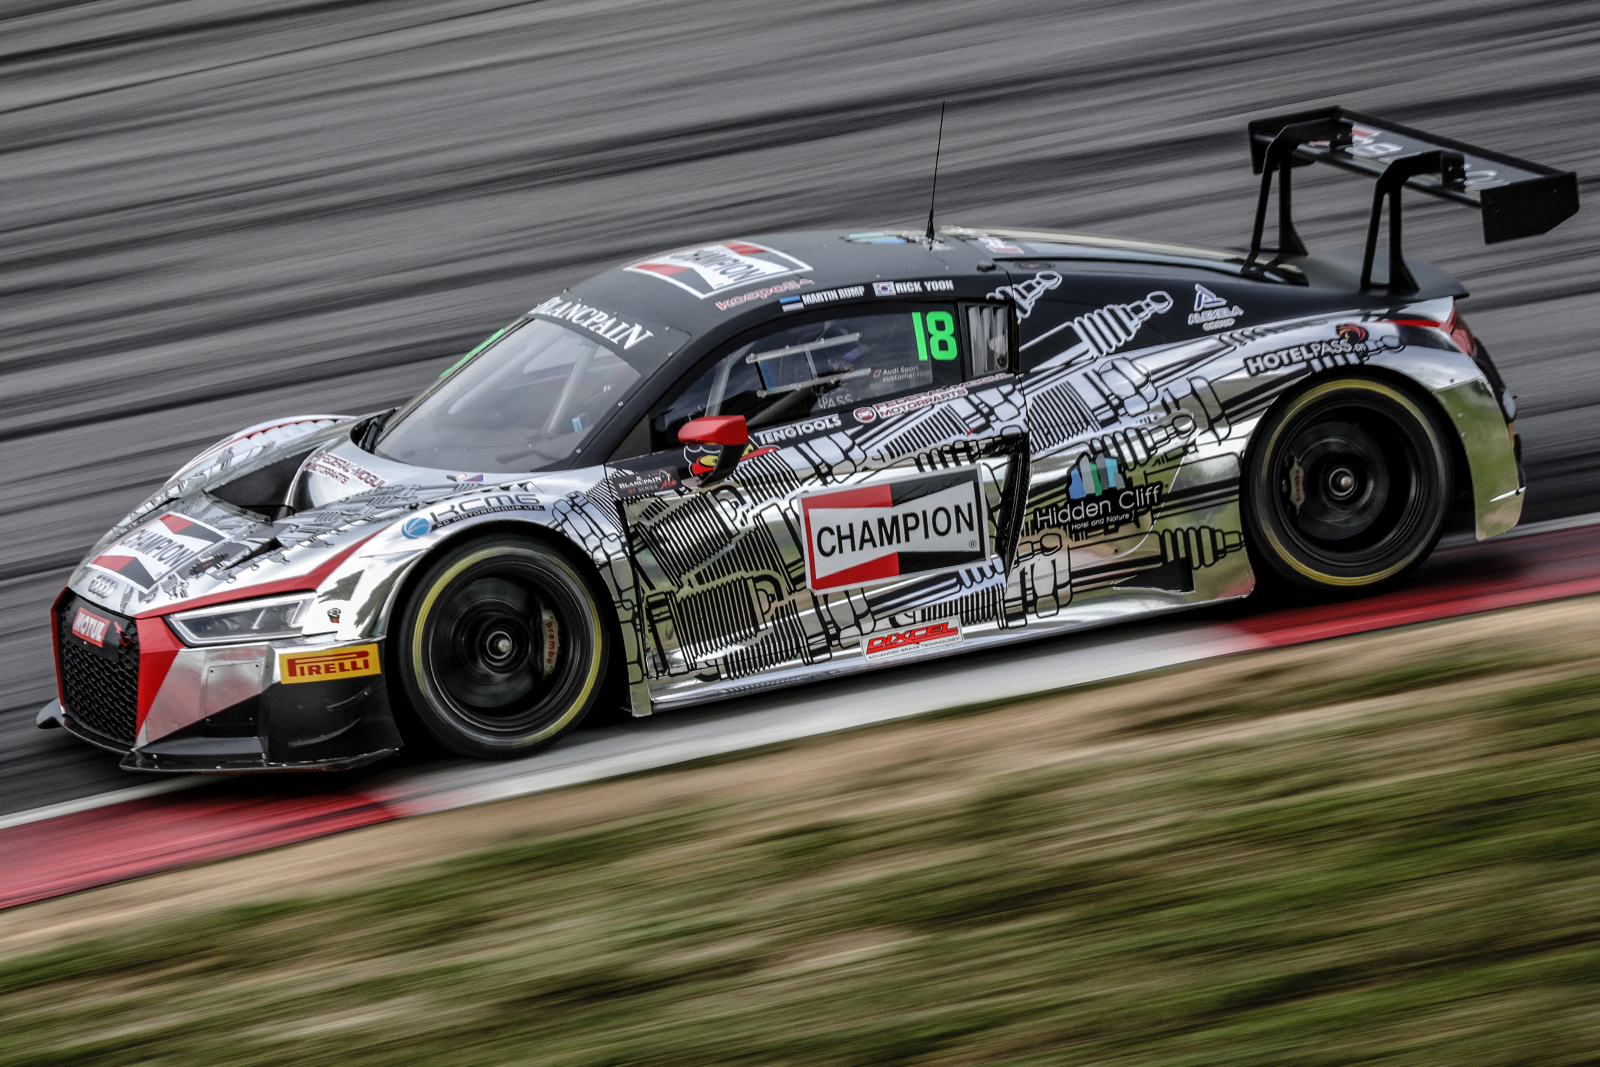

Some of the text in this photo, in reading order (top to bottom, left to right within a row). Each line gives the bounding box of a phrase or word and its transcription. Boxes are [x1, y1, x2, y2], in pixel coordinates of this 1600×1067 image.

[801, 286, 865, 305] MARTIN RUMP
[895, 279, 954, 294] RICK YOON
[527, 296, 654, 350] BLANCPAIN
[911, 310, 958, 361] 18
[882, 365, 919, 376] Audi Sport
[882, 372, 915, 382] customer
[879, 388, 967, 417] MOTORPARTS
[618, 475, 662, 489] BLANCPAIN
[1036, 484, 1160, 529] Hidden Cliff
[816, 502, 975, 558] CHAMPION
[1071, 513, 1130, 531] Hotel and Nature
[119, 528, 196, 568] CHAMPION
[73, 611, 106, 642] MOTUL
[866, 621, 958, 653] DIXCEL
[545, 620, 556, 665] brembo
[900, 645, 921, 653] BRAKE
[287, 650, 370, 677] PIRELLI
